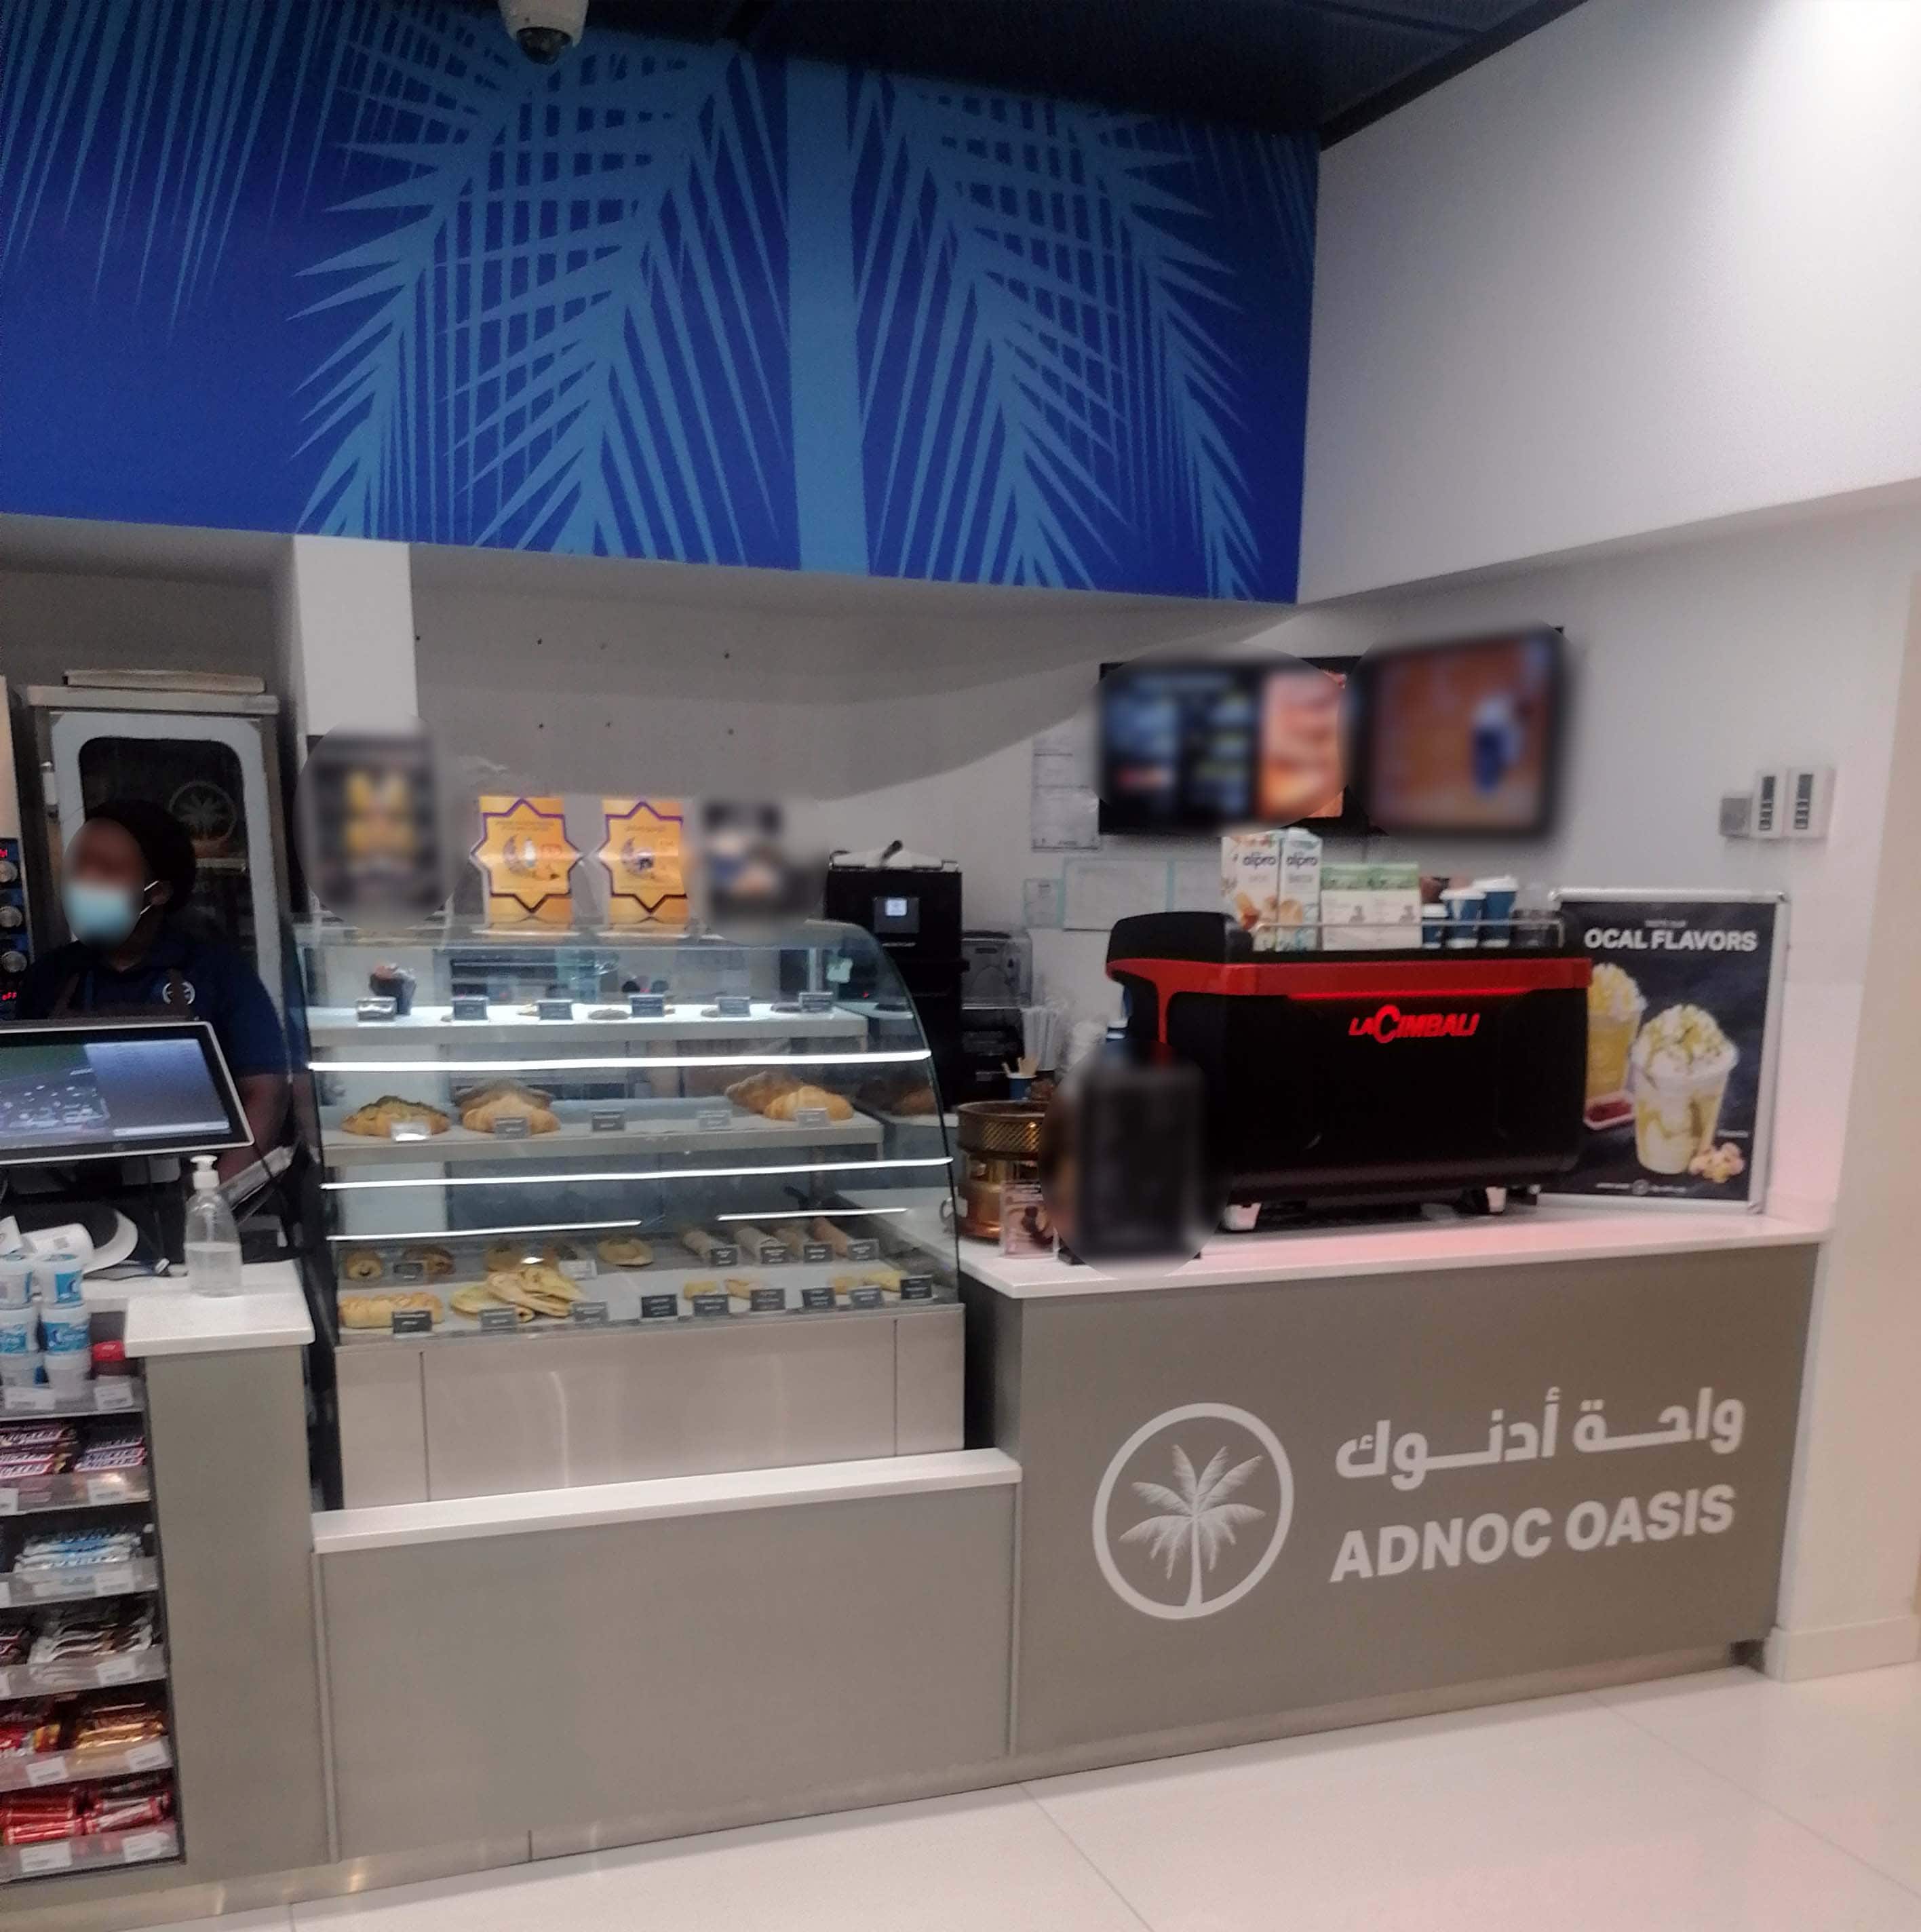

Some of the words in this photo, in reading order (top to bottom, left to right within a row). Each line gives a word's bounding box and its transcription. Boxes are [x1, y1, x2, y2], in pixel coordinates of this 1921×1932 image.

[1243, 852, 1277, 870] alpro
[1286, 852, 1318, 870] alpro
[1650, 929, 1758, 952] FLAVORS
[1328, 1507, 1553, 1583] ADNOC
[1564, 1484, 1736, 1551] OASIS
